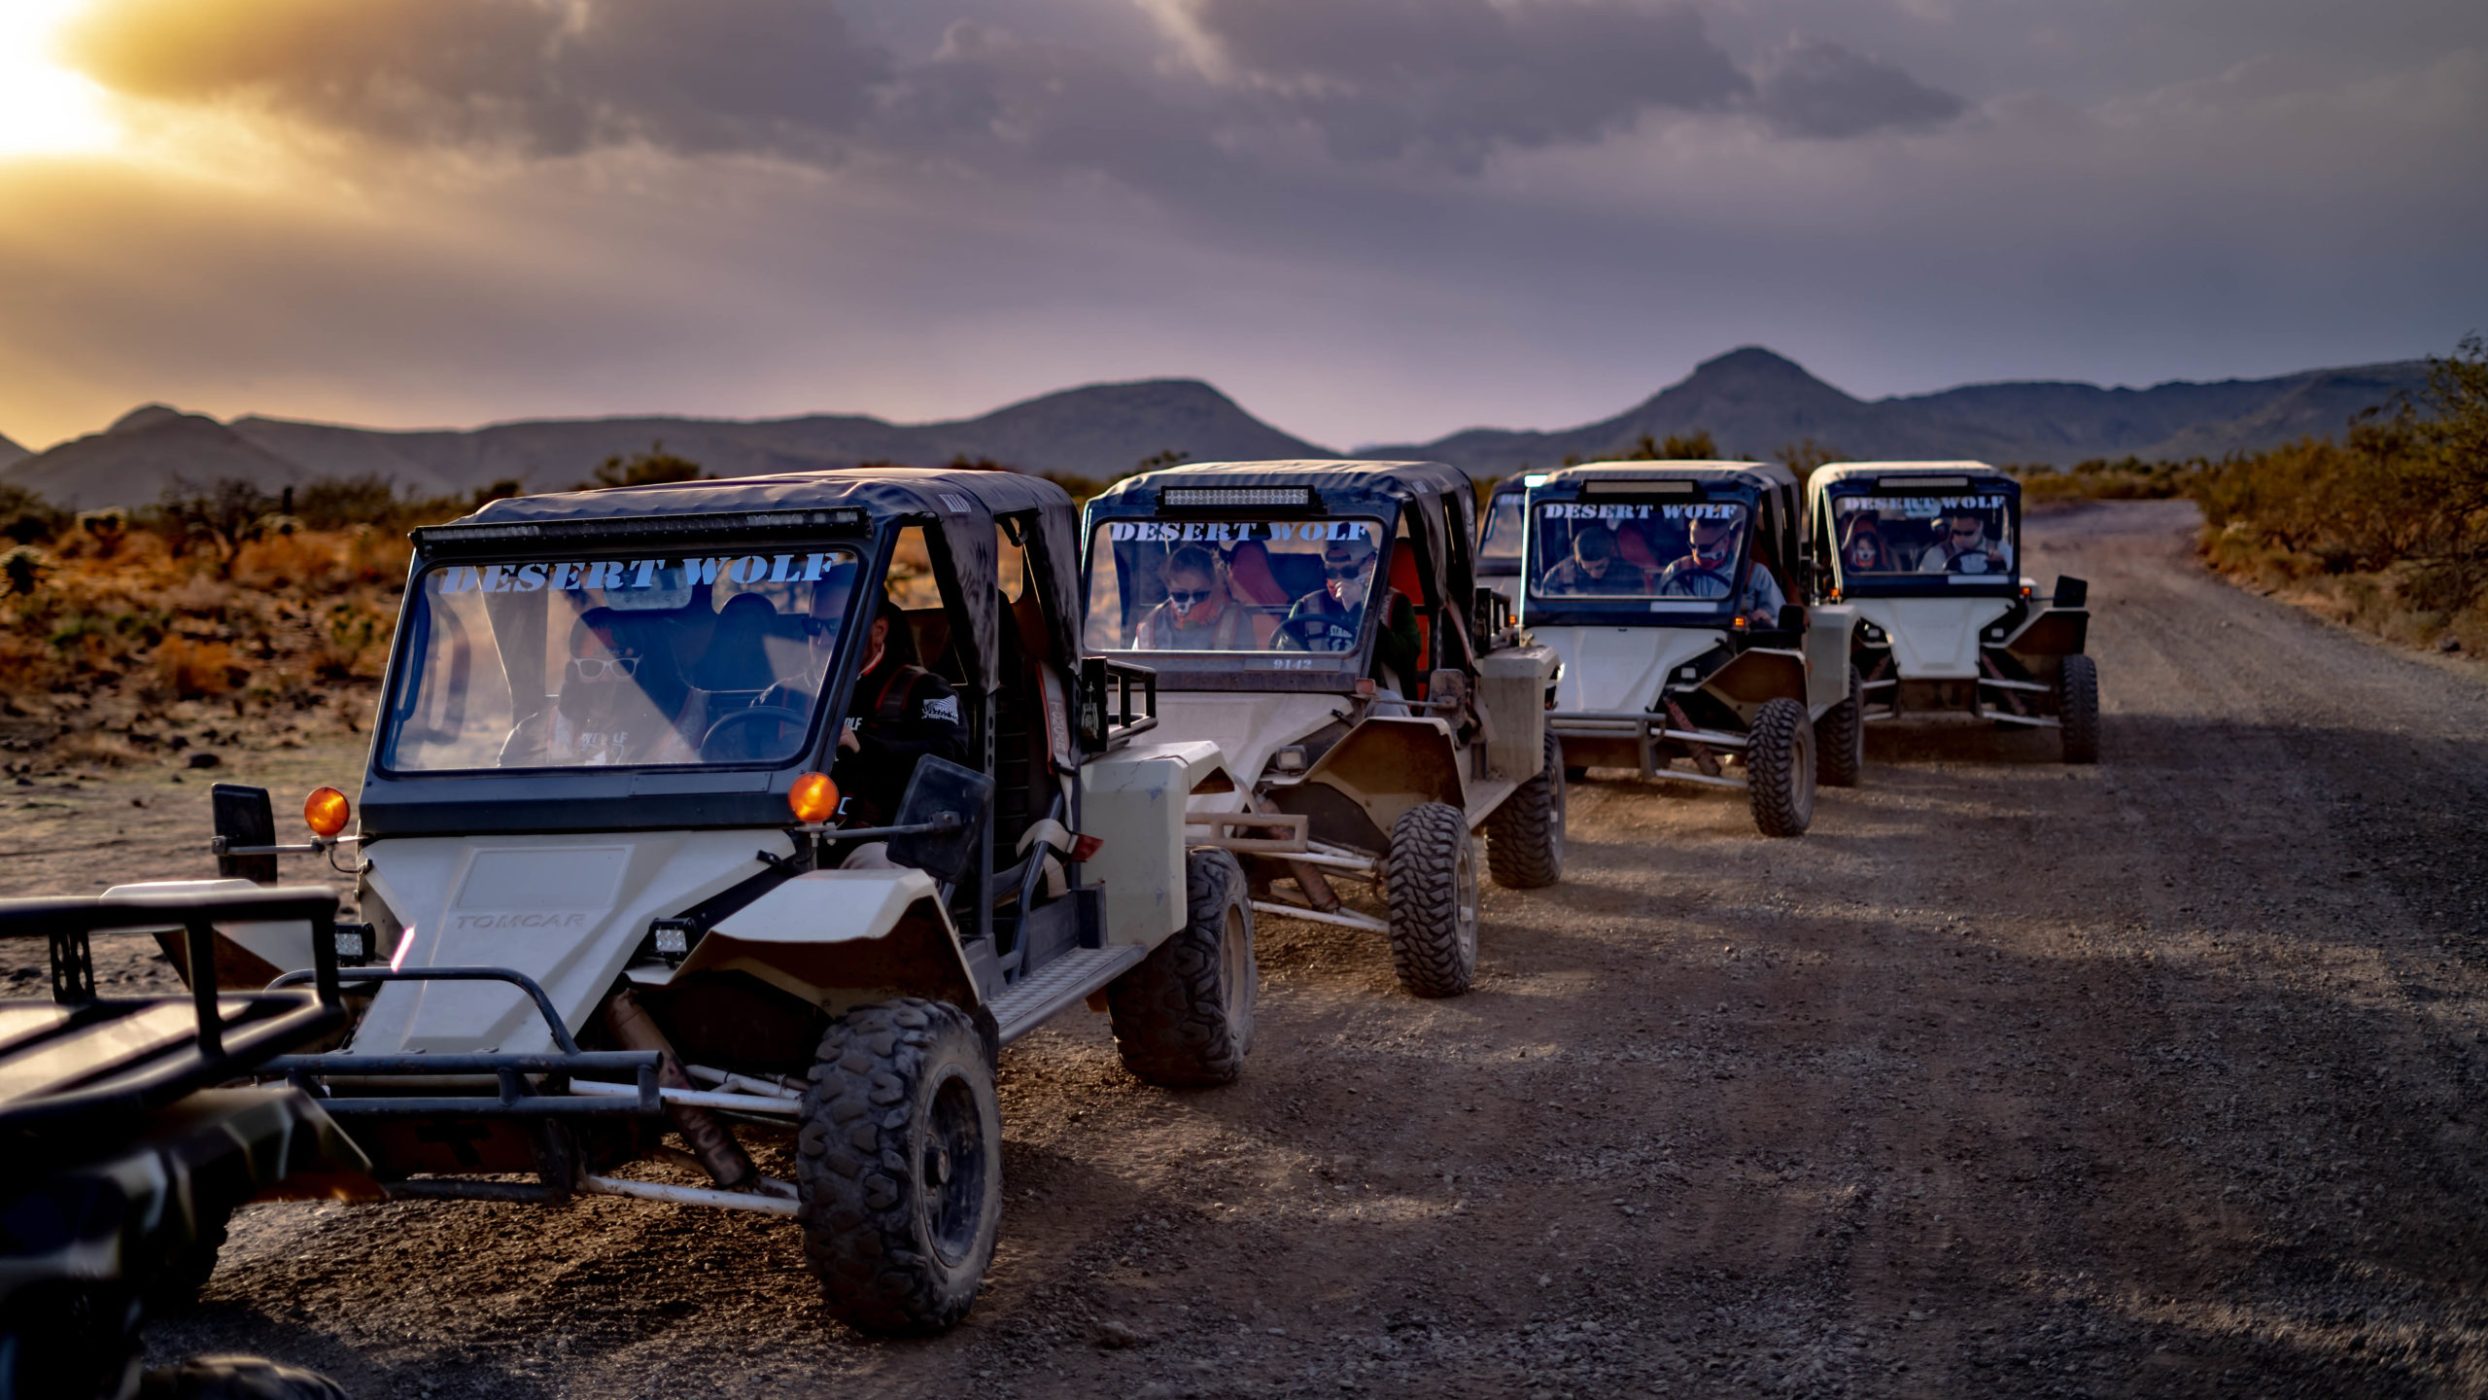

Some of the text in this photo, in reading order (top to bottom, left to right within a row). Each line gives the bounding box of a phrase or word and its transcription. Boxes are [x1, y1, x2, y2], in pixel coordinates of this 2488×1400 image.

[1844, 496, 2005, 510] DESERT WOLF
[1544, 504, 1737, 519] DESERT WOLF
[1110, 521, 1367, 542] DESERT WOLF
[438, 553, 838, 594] DESERT WOLF
[1273, 659, 1312, 670] 9142
[843, 716, 864, 731] OLF
[457, 913, 586, 930] TOMCAR
